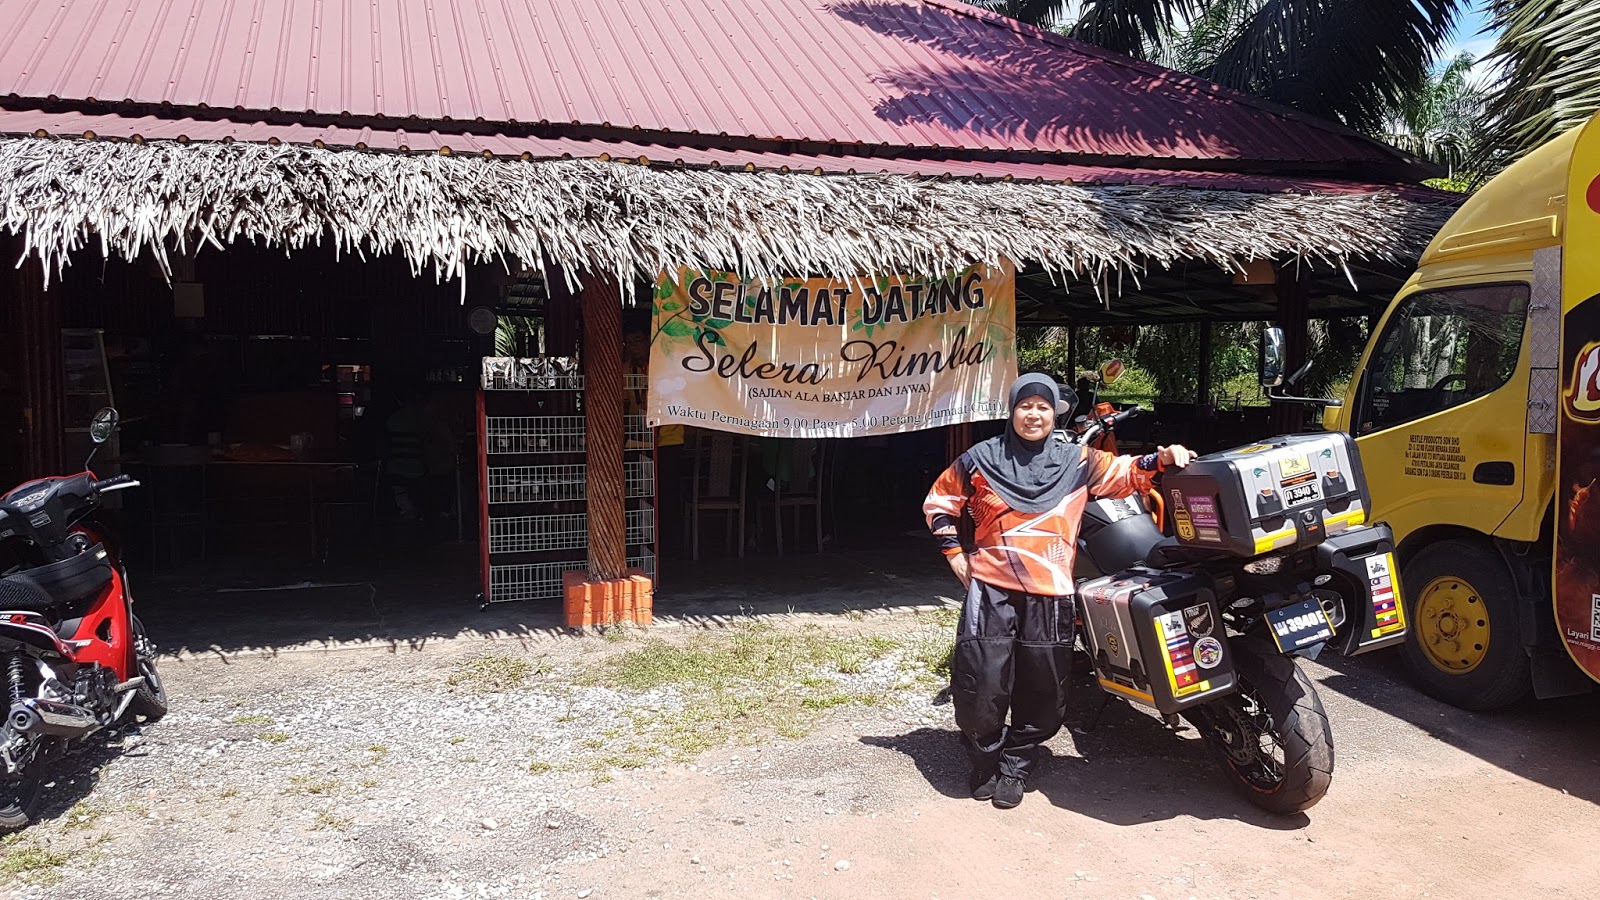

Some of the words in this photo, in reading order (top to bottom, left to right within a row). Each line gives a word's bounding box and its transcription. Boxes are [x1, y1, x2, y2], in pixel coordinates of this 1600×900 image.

[688, 278, 851, 326] SELAMAT
[862, 272, 985, 326] DATANG
[682, 330, 830, 385] Selera
[840, 326, 994, 383] Rimba
[749, 387, 792, 399] (SAJIAN
[794, 391, 820, 402] ALA
[822, 389, 866, 403] BANJAR
[868, 387, 893, 398] DAN
[895, 384, 931, 396] JAWA)
[668, 405, 707, 420] Waktu
[711, 411, 779, 430] Perniagaan
[783, 417, 808, 429] 9.00
[812, 418, 838, 432] Pagi
[852, 416, 878, 428] 5.00
[882, 412, 921, 427] Petang
[925, 404, 967, 424] (Jumaat
[971, 399, 1003, 414] Cuti)
[1410, 435, 1423, 444] NESTLE
[1424, 436, 1442, 445] PRODUCTS
[1181, 526, 1191, 536] 12
[1567, 628, 1590, 640] Layari
